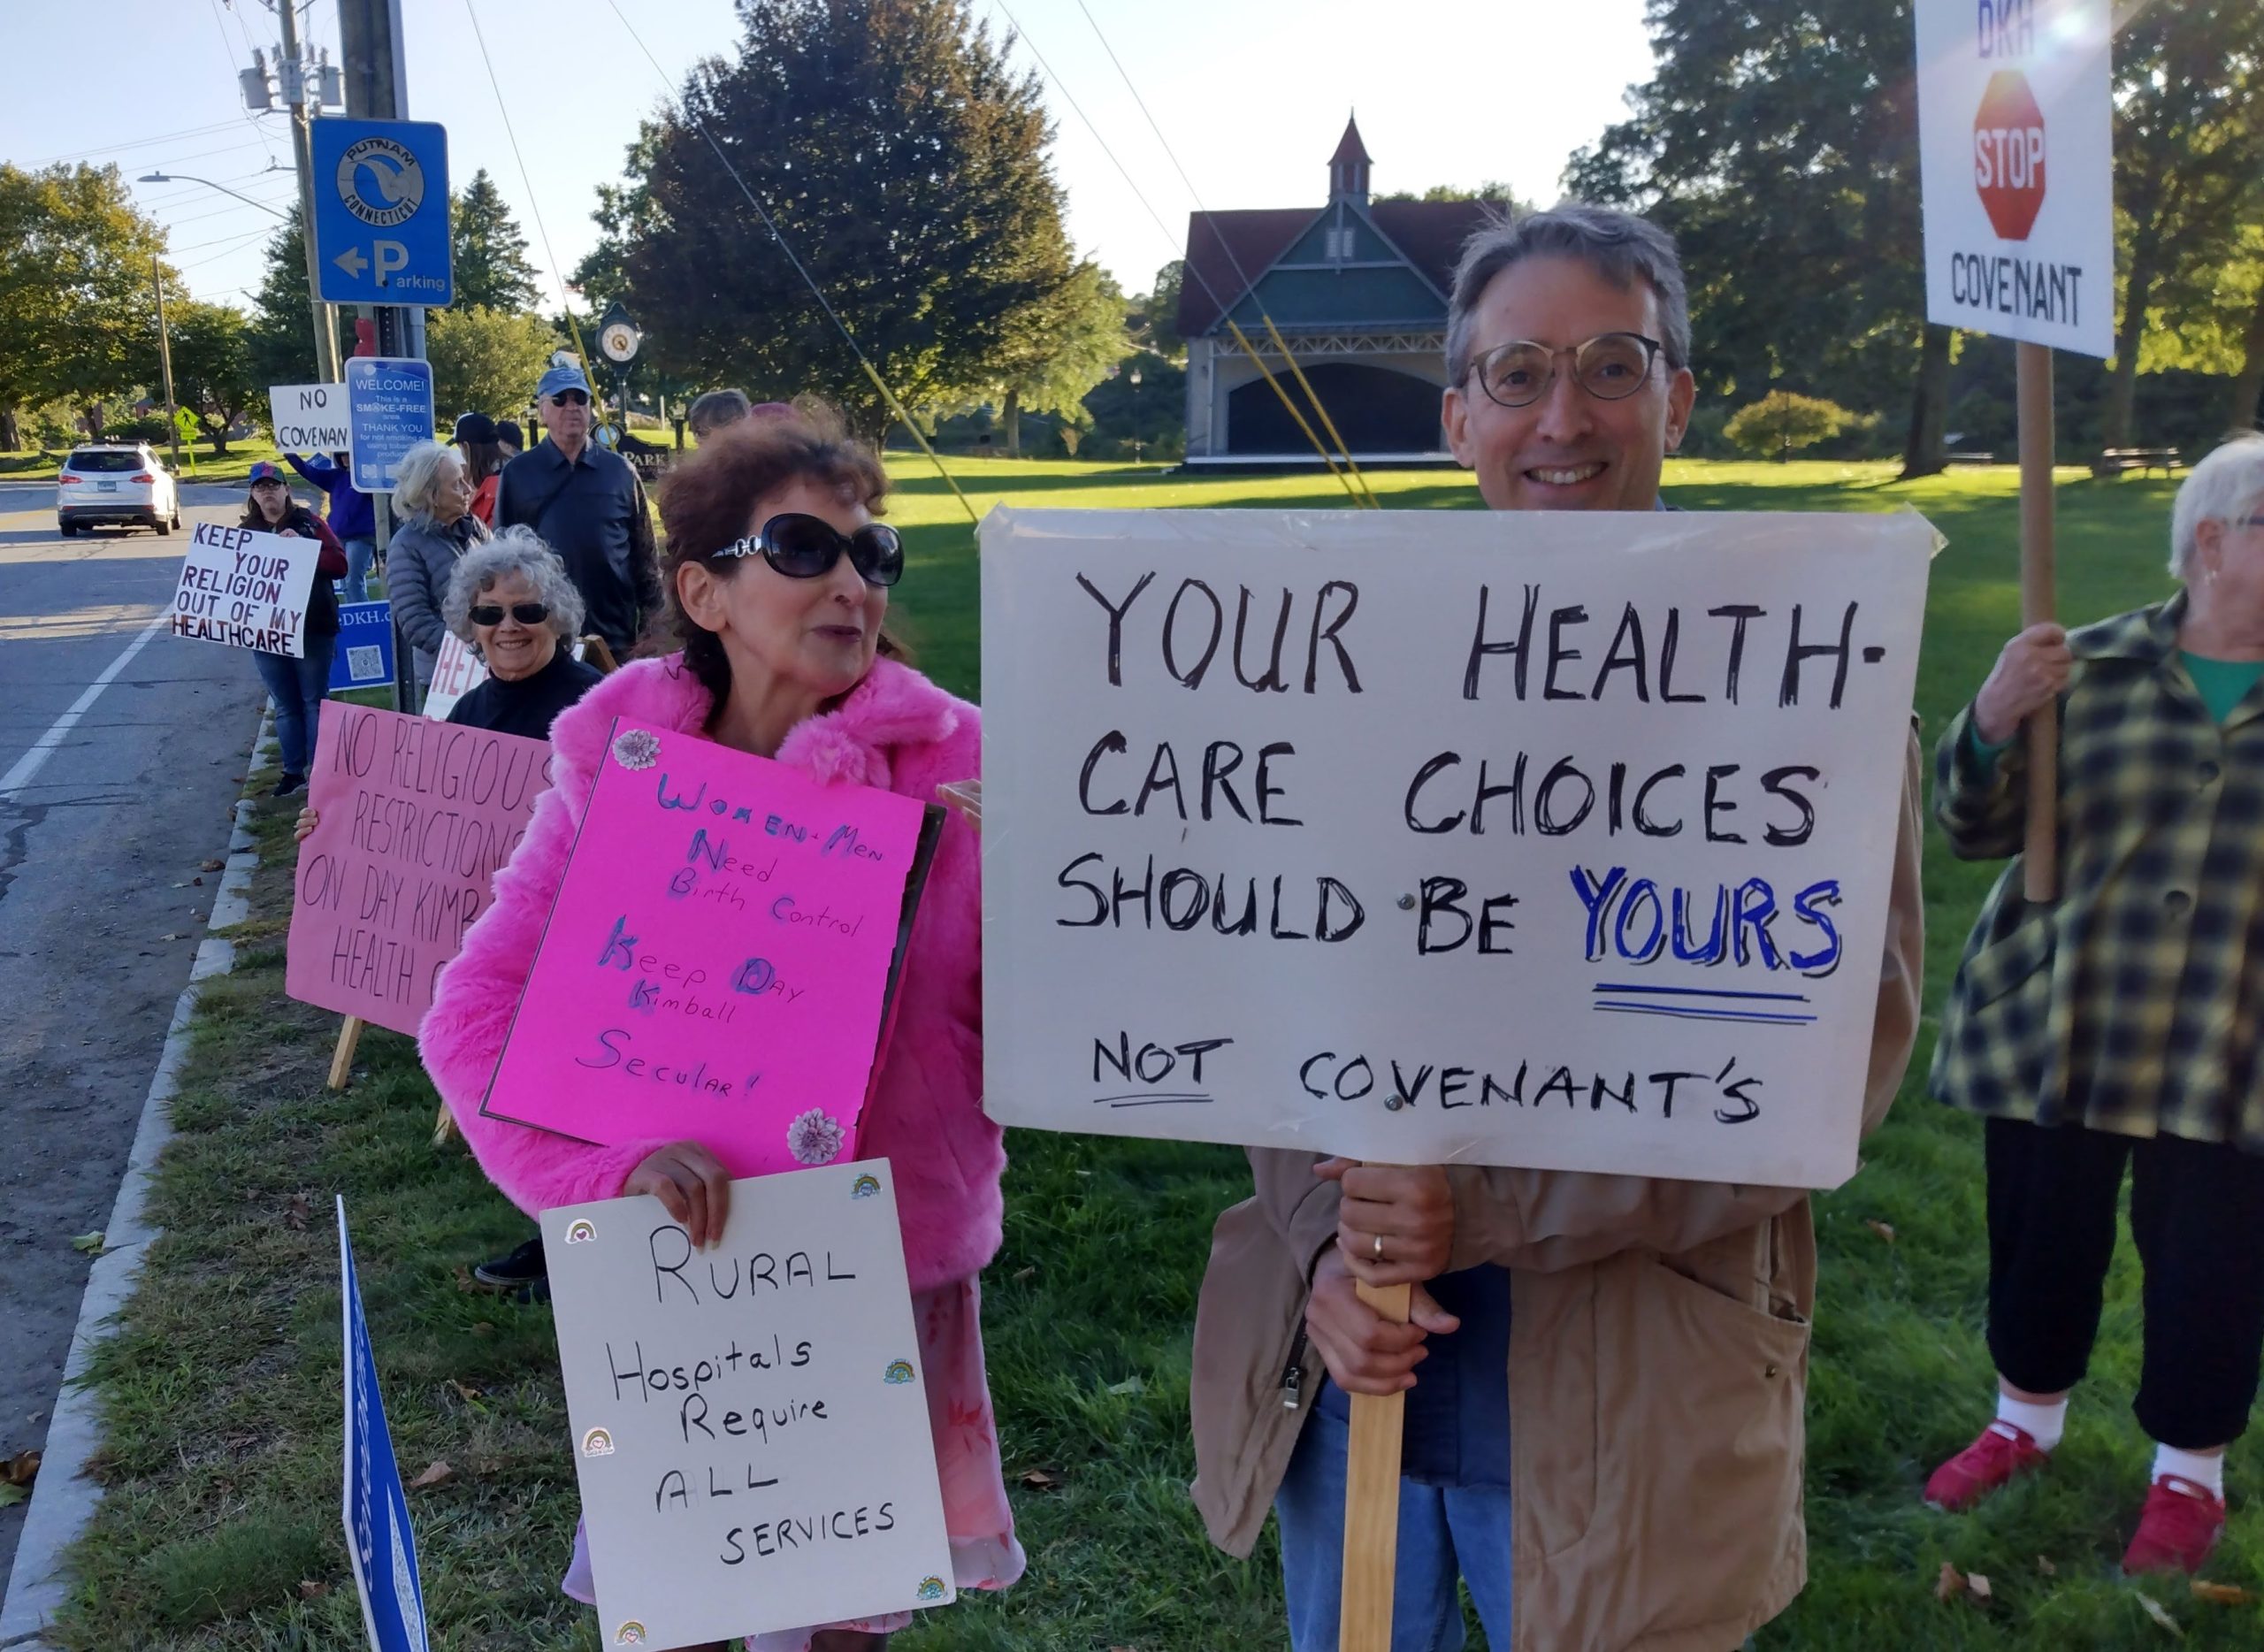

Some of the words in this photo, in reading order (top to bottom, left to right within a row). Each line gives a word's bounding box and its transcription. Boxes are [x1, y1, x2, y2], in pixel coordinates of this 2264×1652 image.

[1978, 0, 2033, 58] DKH
[346, 140, 416, 166] PUTNAM
[1975, 127, 2045, 189] STOP
[344, 195, 419, 225] CONNECTICUT
[373, 240, 446, 292] Parking
[1951, 252, 2082, 326] COVENANT
[300, 389, 327, 410] NO
[356, 379, 424, 391] WELCOME!
[279, 426, 348, 447] COVENAN
[623, 451, 667, 466] PARK
[194, 523, 253, 551] KEEP
[181, 565, 282, 605] RELIGION
[234, 552, 290, 581] YOUR
[171, 613, 294, 656] HEALTHCARE
[177, 591, 220, 617] OUT
[230, 601, 260, 625] OF
[270, 607, 302, 633] MY
[1075, 571, 1363, 693] YOUR
[1463, 584, 1885, 709] HEALTH-
[334, 710, 378, 777] NO
[1079, 730, 1304, 826] CARE
[1404, 751, 1820, 847] CHOICES
[688, 828, 777, 883] Need
[302, 854, 347, 911] ON
[360, 864, 403, 929] DAY
[412, 877, 483, 952] KIMB
[670, 867, 745, 911] Birth
[771, 897, 864, 937] Control
[1056, 853, 1365, 943] SHOULD
[1418, 876, 1518, 955] BE
[1569, 865, 1843, 977] YOURS
[331, 925, 414, 1006] HEALTH
[598, 914, 707, 989] Keep
[631, 978, 736, 1023] Kimball
[1092, 1030, 1235, 1084] NOT
[1299, 1056, 1763, 1123] COVENANT'S
[649, 1225, 856, 1305] RURAL
[606, 1334, 812, 1403] Hospitals
[681, 1393, 828, 1444] Require
[656, 1464, 778, 1513] ALL
[720, 1502, 895, 1564] SERVICES
